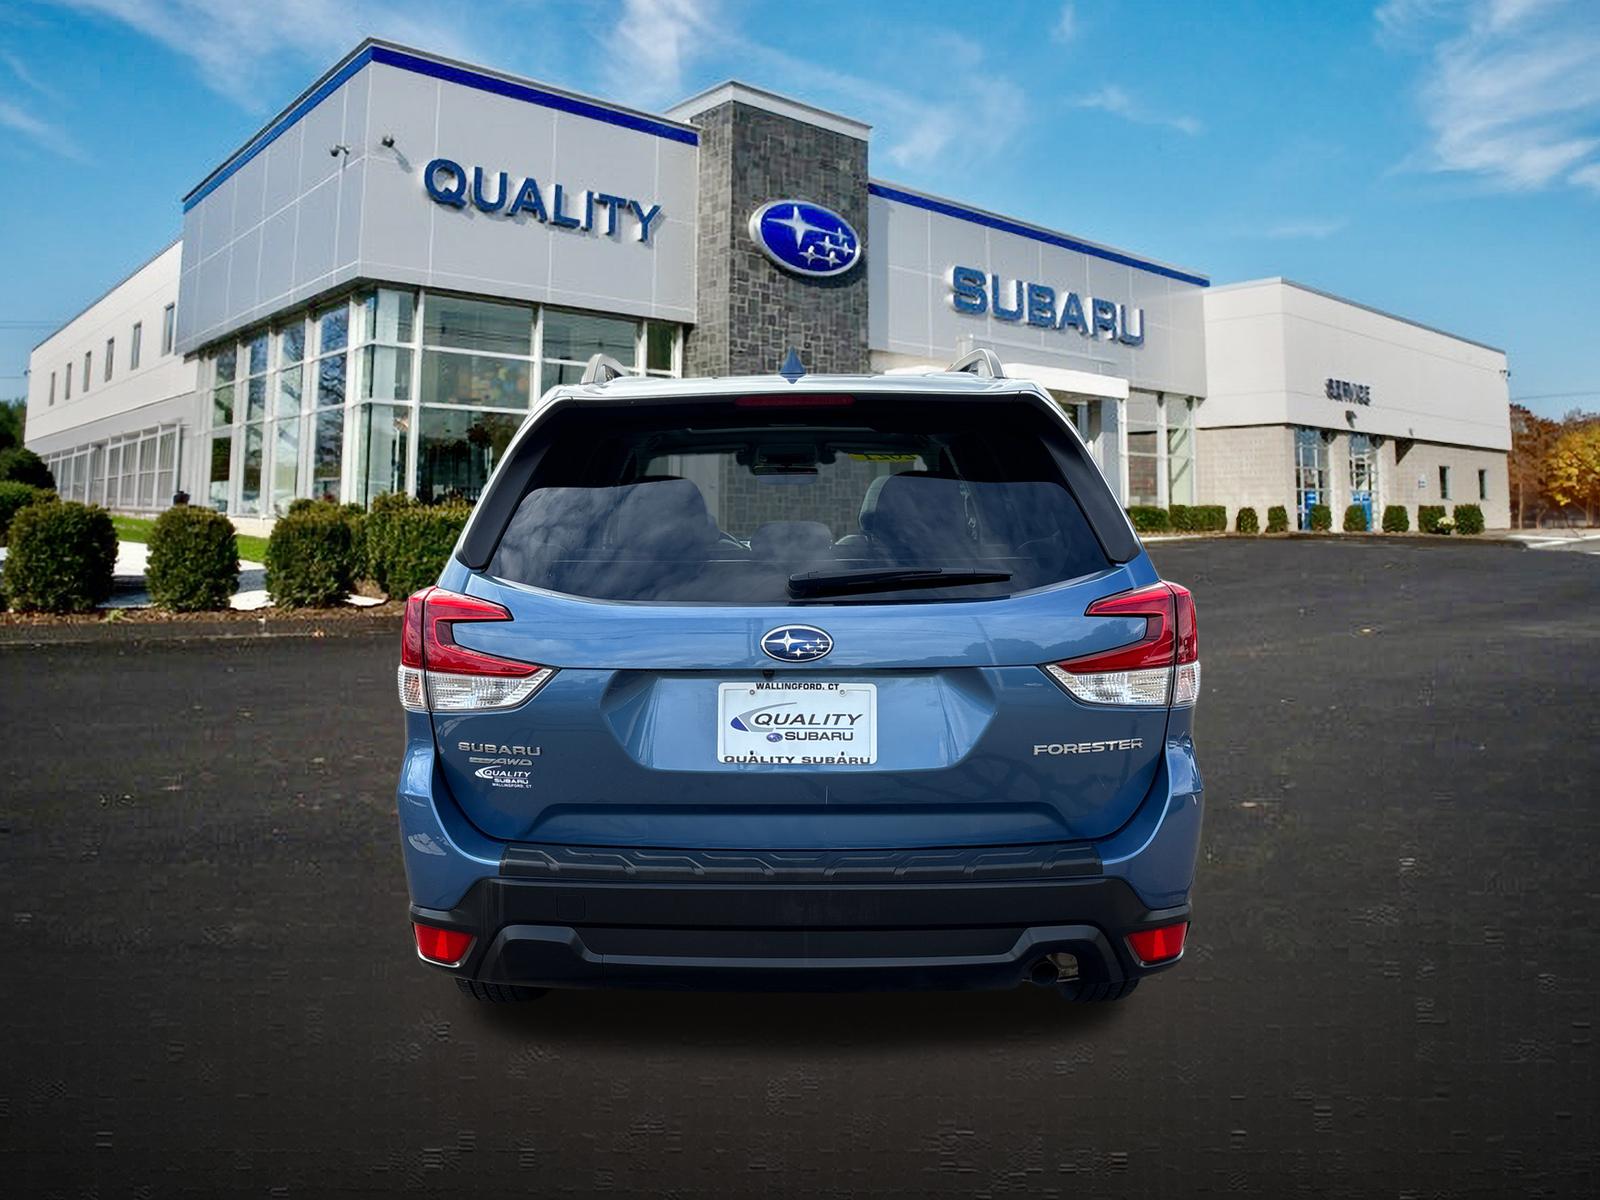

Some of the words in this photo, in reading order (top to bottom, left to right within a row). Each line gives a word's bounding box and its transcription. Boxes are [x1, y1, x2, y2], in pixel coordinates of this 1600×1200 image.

[424, 158, 661, 243] QUALITY
[951, 265, 1146, 346] SUBARU
[828, 683, 840, 691] CT
[754, 713, 863, 726] QUALITY
[785, 732, 853, 741] SUBARU
[458, 741, 541, 756] SUBARU
[1033, 738, 1143, 756] FORESTER
[724, 755, 795, 764] QUALITY
[802, 756, 870, 764] SUBARU
[485, 769, 531, 778] QUALITY
